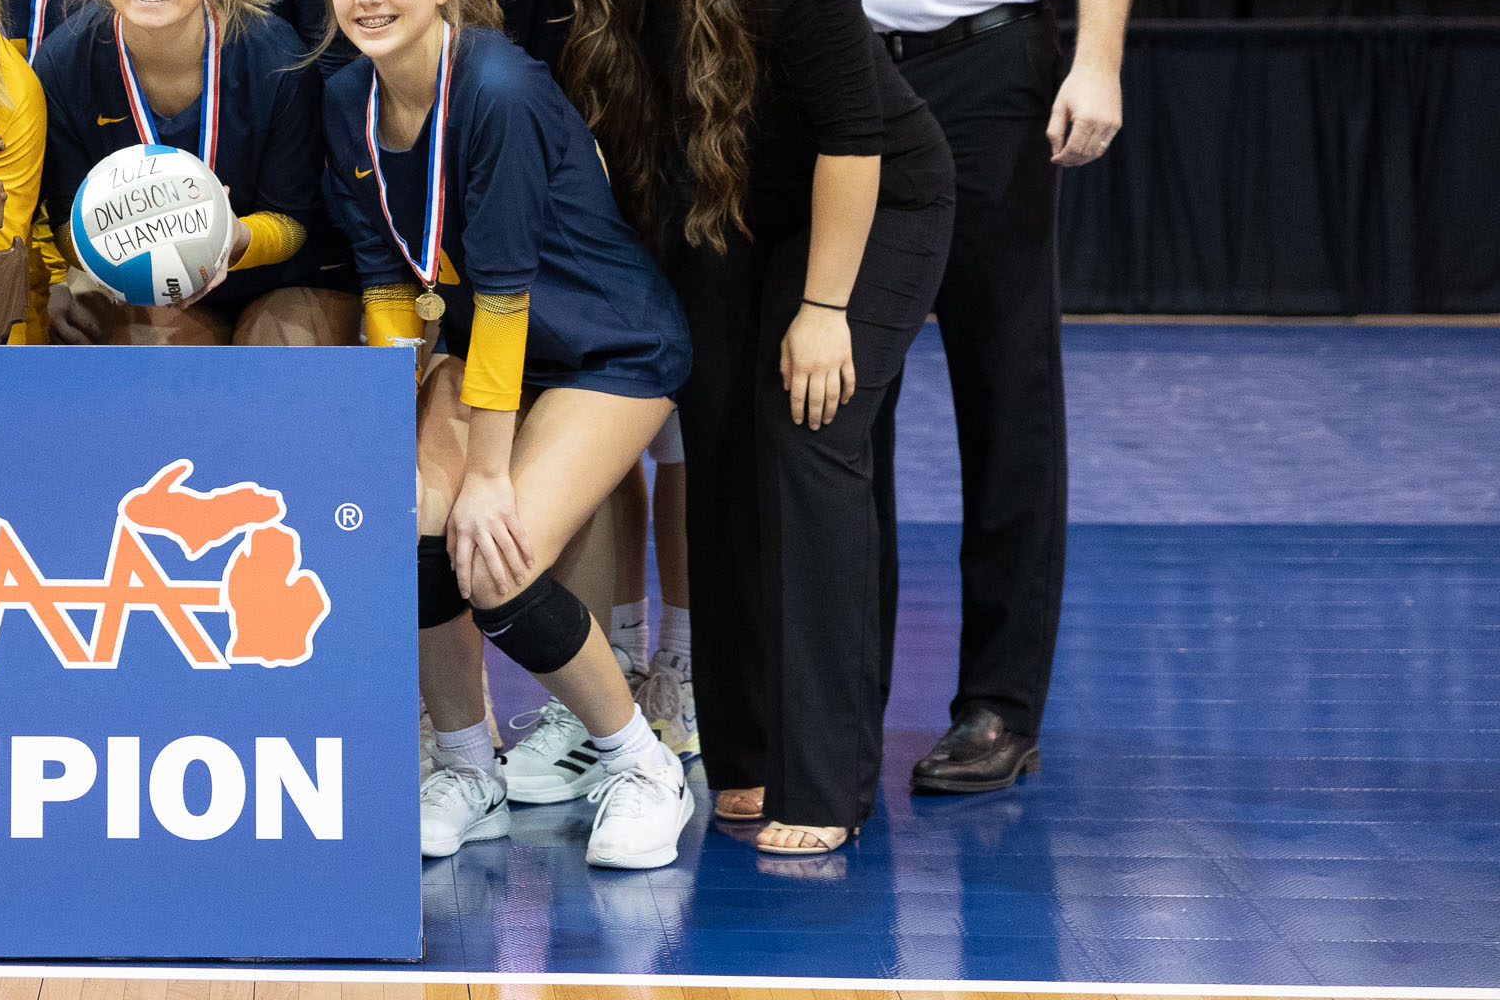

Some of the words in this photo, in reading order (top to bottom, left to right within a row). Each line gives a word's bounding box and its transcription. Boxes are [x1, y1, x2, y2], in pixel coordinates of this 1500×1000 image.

[109, 157, 162, 190] 2022
[94, 180, 180, 231] DIVISION
[182, 177, 200, 199] 3
[104, 206, 208, 261] CHAMPION
